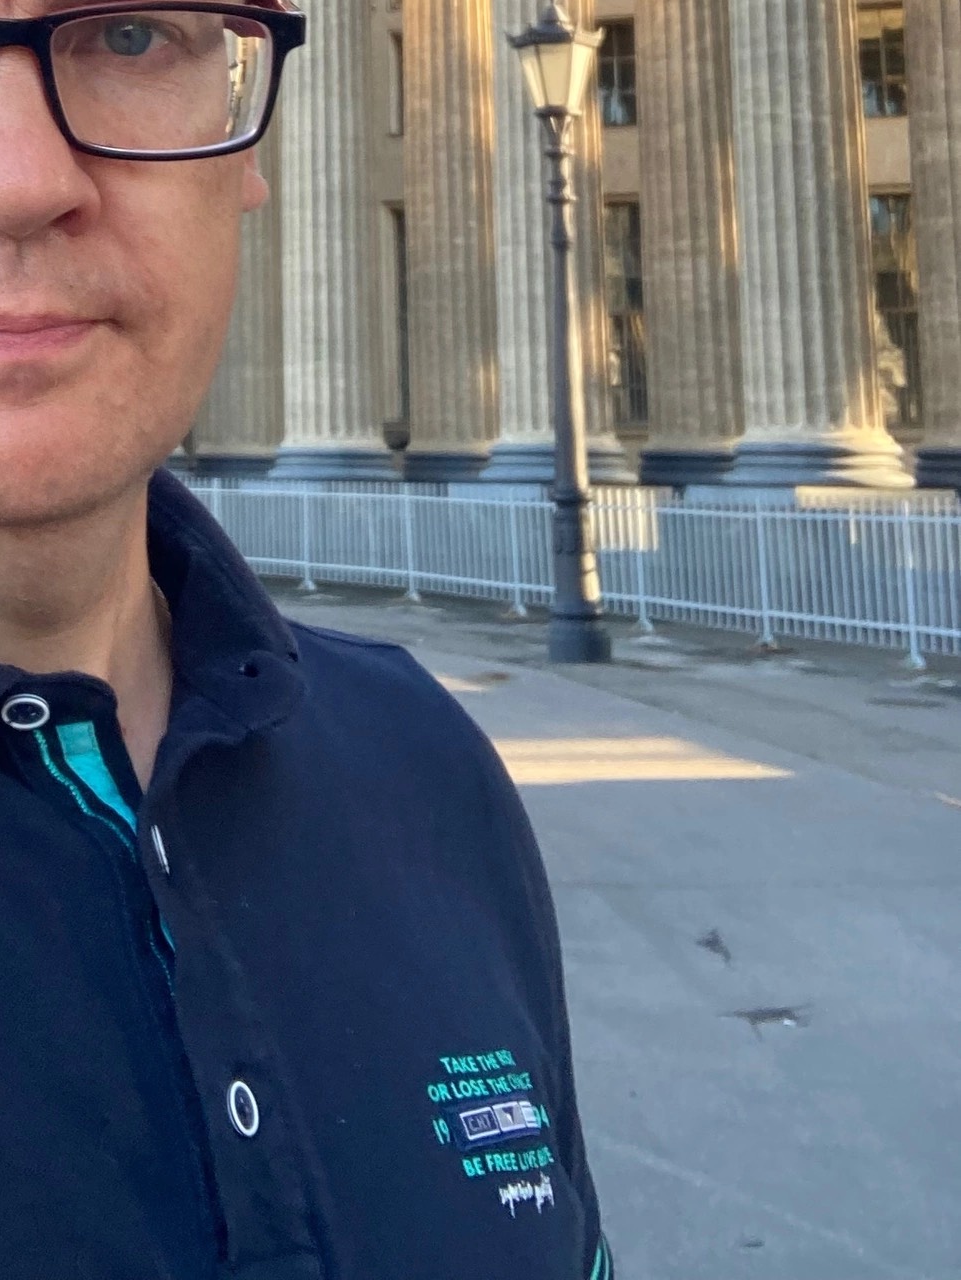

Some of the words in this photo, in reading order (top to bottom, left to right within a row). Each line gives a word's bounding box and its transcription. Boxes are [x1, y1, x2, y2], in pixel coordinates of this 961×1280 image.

[440, 1056, 479, 1074] TAKE
[476, 1053, 500, 1071] THE
[428, 1082, 453, 1102] OR
[450, 1079, 489, 1099] LOSE
[486, 1076, 512, 1095] THE
[462, 1157, 486, 1177] BE
[485, 1152, 519, 1172] FREE
